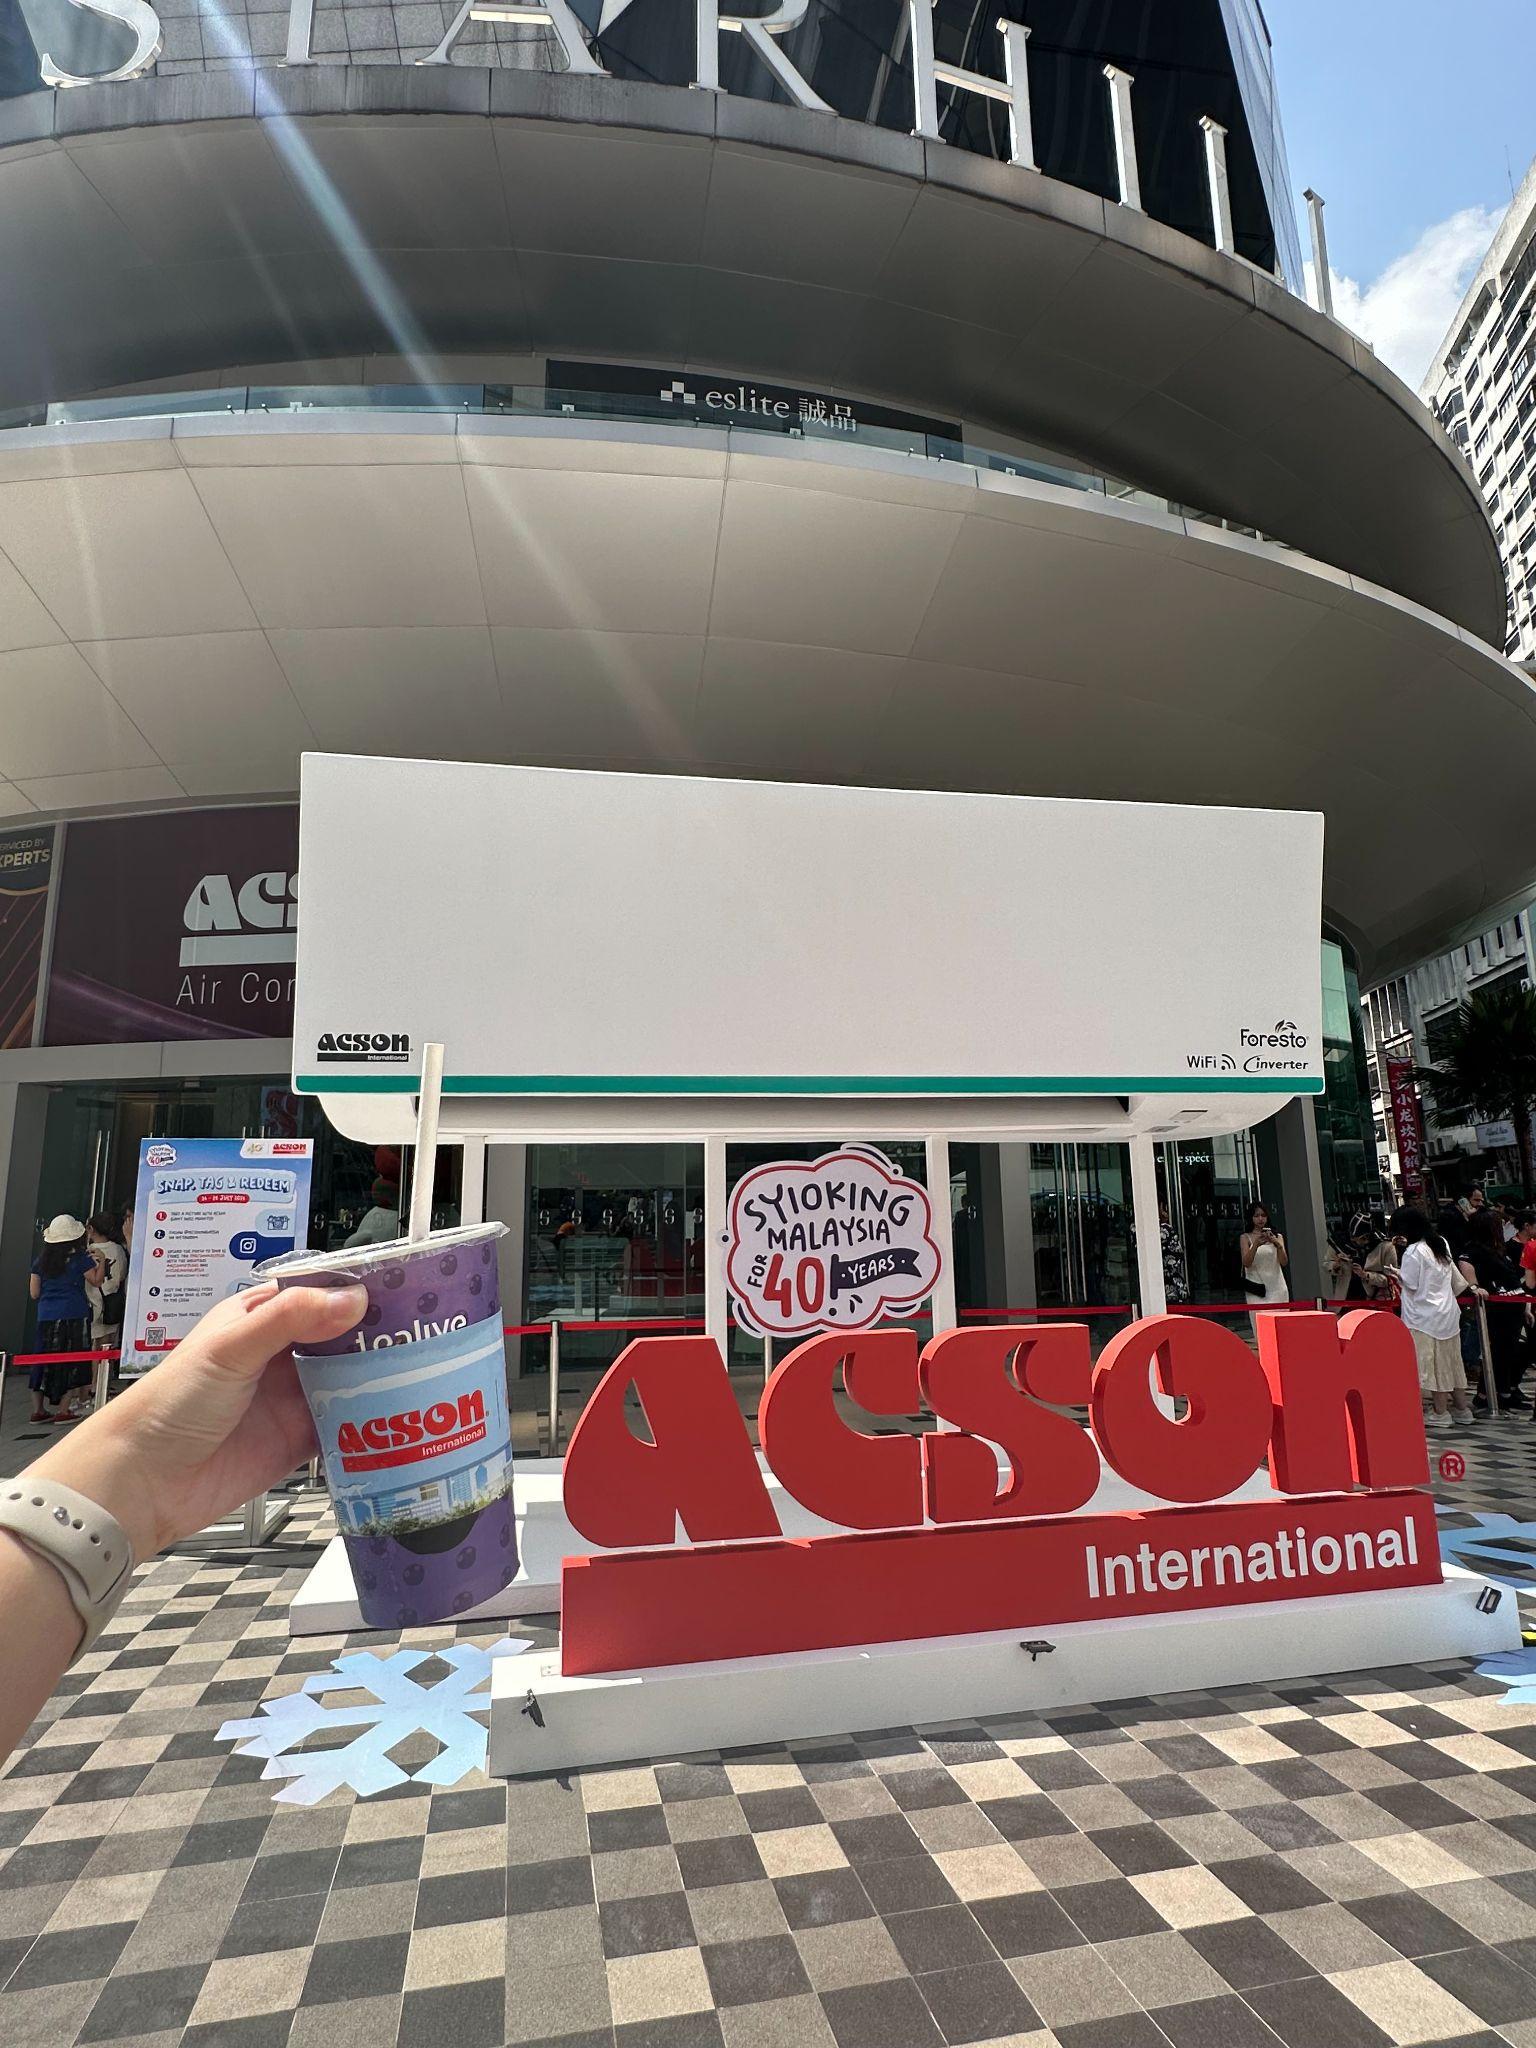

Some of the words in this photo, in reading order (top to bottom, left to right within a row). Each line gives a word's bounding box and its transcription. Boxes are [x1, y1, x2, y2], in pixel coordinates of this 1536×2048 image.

[705, 386, 791, 418] eslite
[799, 397, 858, 432] 誠品
[183, 871, 298, 931] AC
[176, 973, 222, 1006] Air
[1240, 1028, 1307, 1049] Foresto
[1187, 1055, 1217, 1069] WiFi
[1255, 1056, 1309, 1070] inverter
[200, 1176, 224, 1190] TAG
[240, 1177, 291, 1193] REDEEM
[744, 1181, 914, 1232] SYIOKING
[768, 1216, 891, 1252] MALAYSIA
[747, 1254, 768, 1288] FOR
[763, 1253, 825, 1318] 40
[847, 1254, 896, 1284] YEARS
[422, 1425, 485, 1457] International
[1086, 1515, 1419, 1599] International
